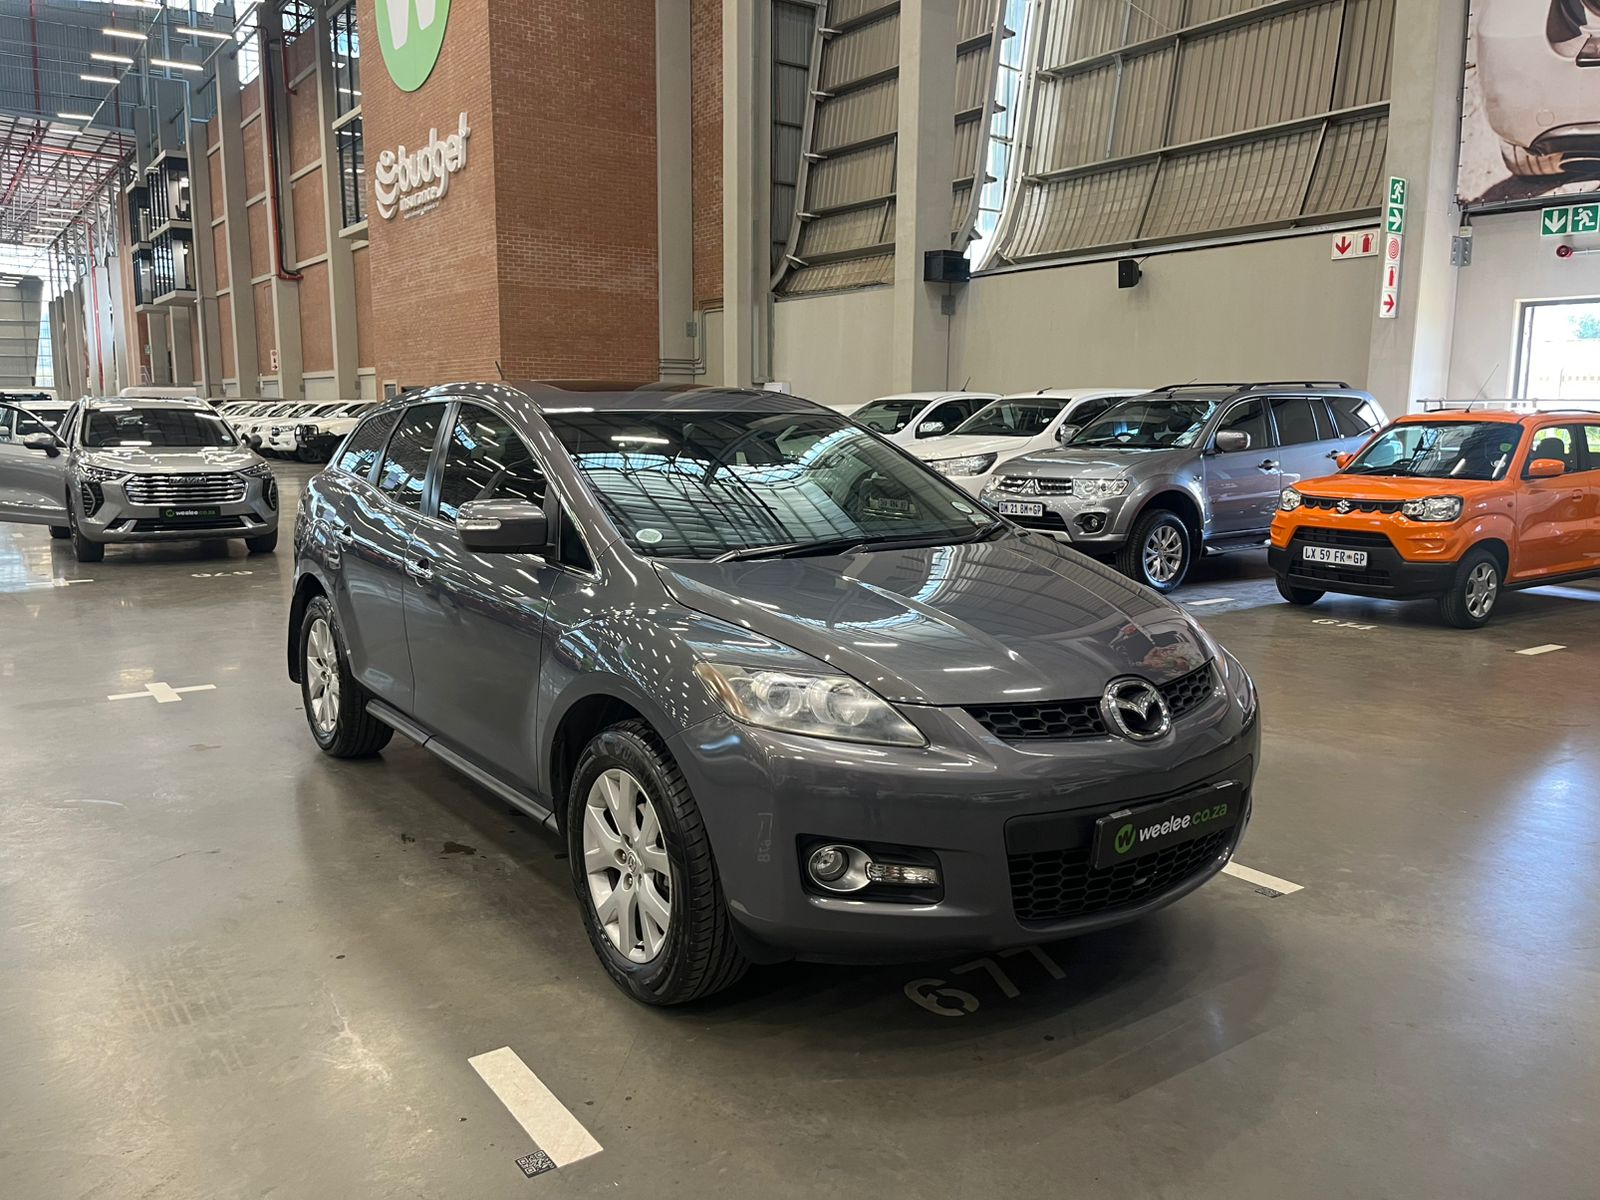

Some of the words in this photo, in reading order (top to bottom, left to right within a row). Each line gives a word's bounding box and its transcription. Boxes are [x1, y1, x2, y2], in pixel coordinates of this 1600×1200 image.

[398, 112, 471, 199] budget
[1032, 504, 1042, 515] GP
[1304, 547, 1317, 560] LX
[1319, 549, 1331, 561] 59
[1334, 550, 1346, 563] FR
[1353, 552, 1365, 565] GP
[1139, 803, 1228, 842] weelee.co.za
[903, 944, 1067, 1017] 677
